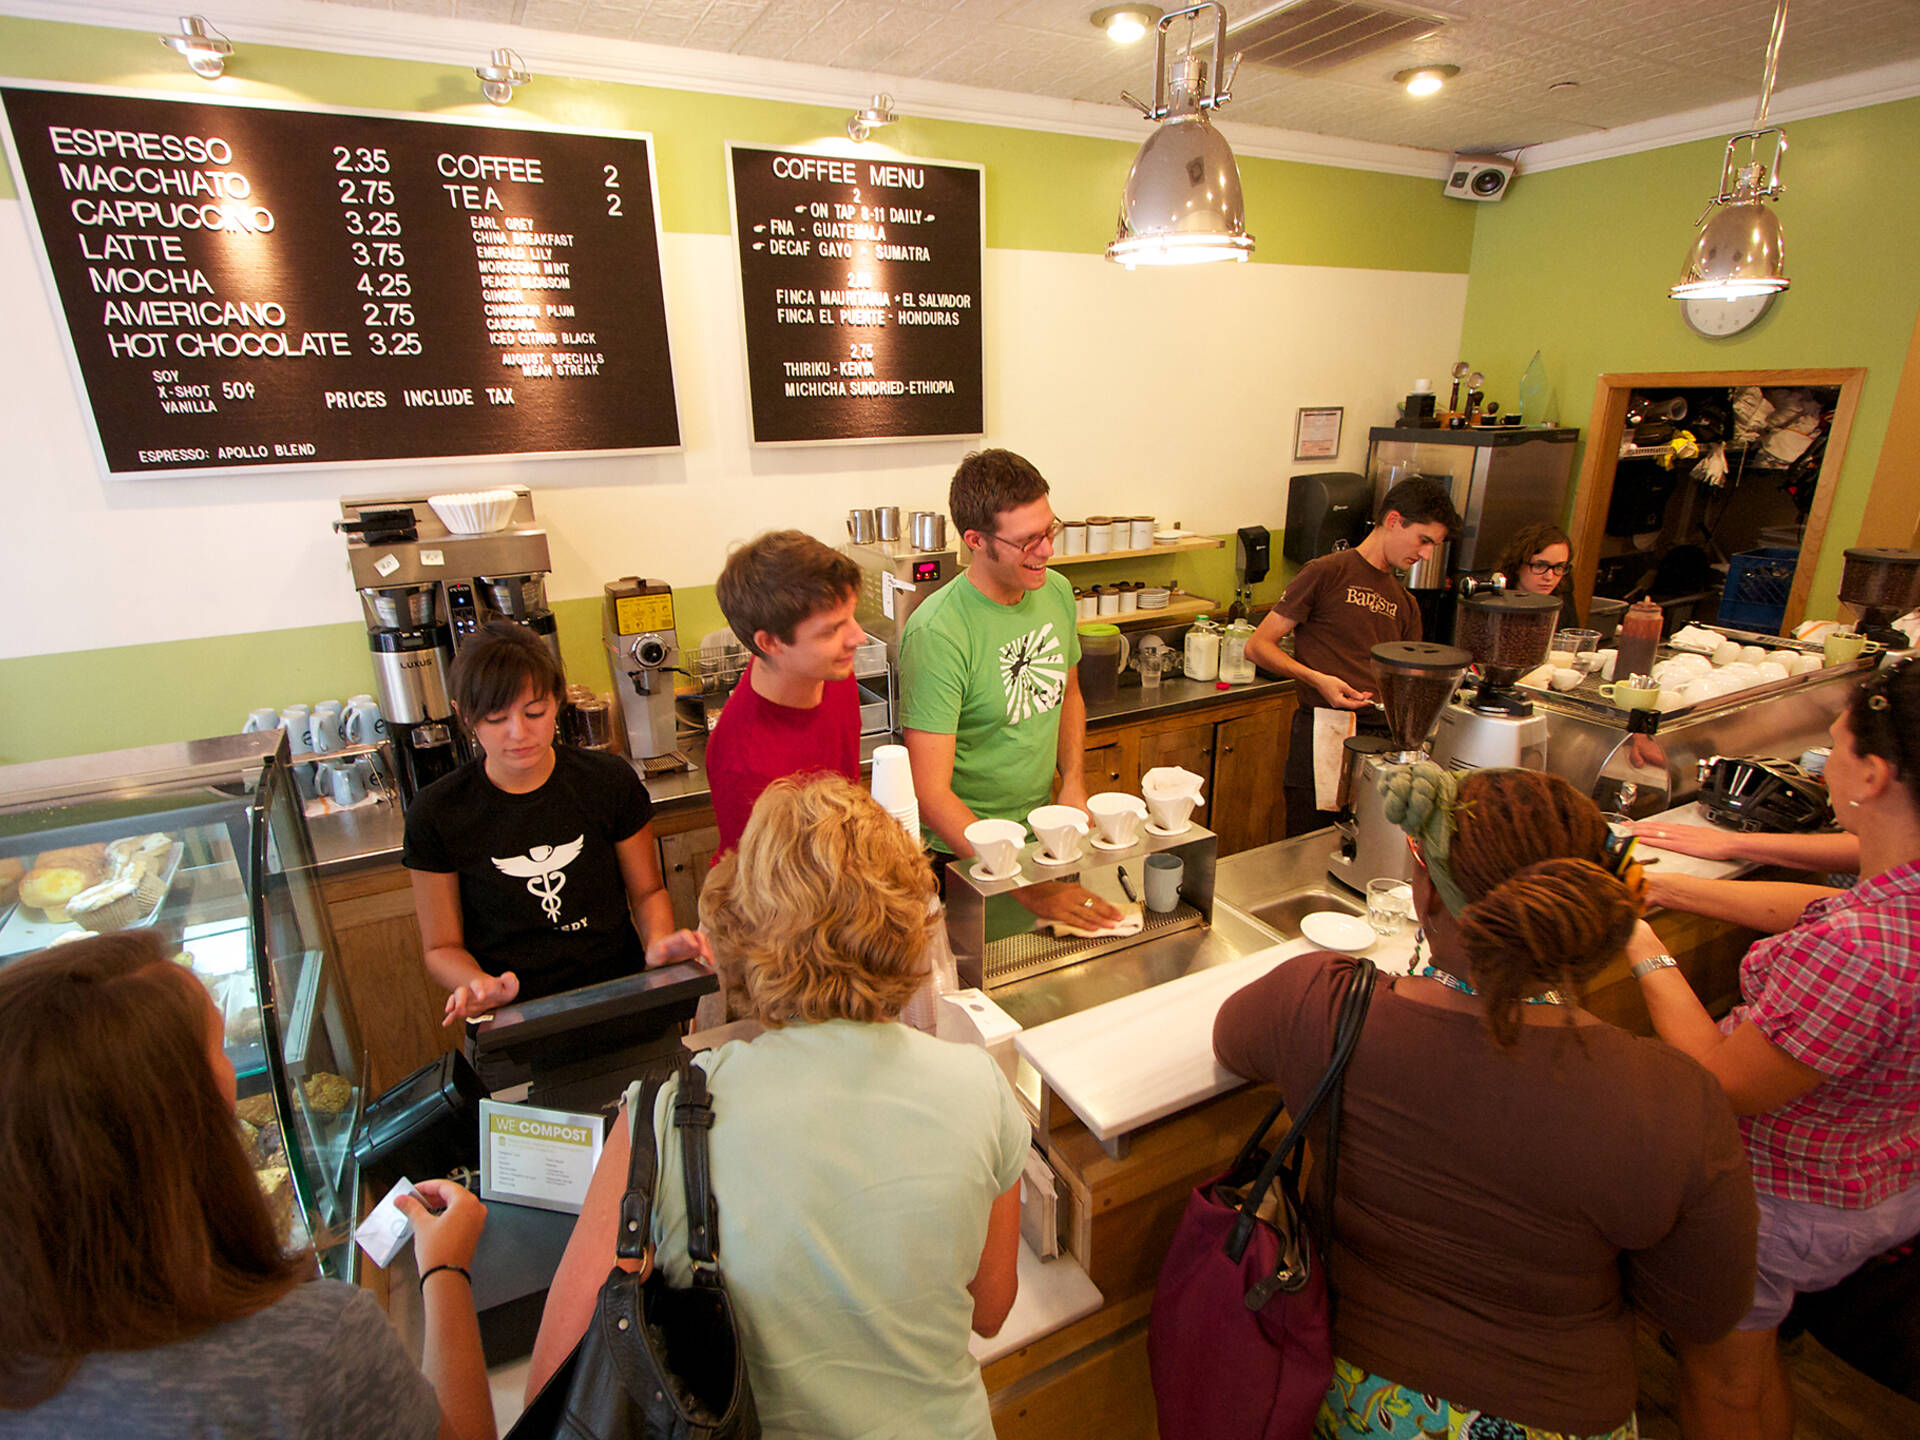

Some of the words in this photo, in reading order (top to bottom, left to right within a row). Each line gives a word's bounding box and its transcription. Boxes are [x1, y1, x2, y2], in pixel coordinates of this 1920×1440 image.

[49, 126, 232, 165] ESPRESSO
[333, 146, 390, 174] 2.35
[437, 153, 544, 184] COFFEE
[603, 164, 620, 189] 2
[772, 157, 857, 185] COFFEE
[870, 164, 925, 189] MENU
[58, 162, 250, 199] MACCHIATO
[338, 179, 395, 206] 2.75
[443, 184, 504, 211] TEA
[606, 193, 623, 217] 2
[852, 188, 861, 204] 2
[71, 199, 274, 233] CAPPUCCNO
[345, 211, 402, 236] 3.25
[810, 203, 829, 219] ON
[834, 204, 856, 220] TAP
[890, 207, 922, 225] DAILY
[471, 215, 499, 230] EARL
[505, 217, 534, 231] GREY
[770, 219, 795, 236] FNA
[472, 231, 508, 245] CHINA
[512, 232, 574, 247] BREAKFAST
[79, 233, 186, 262] LATTE
[352, 243, 405, 267] 3.75
[476, 246, 525, 260] EMERALD
[530, 247, 552, 261] LILY
[770, 239, 811, 257] DECAF
[819, 242, 851, 258] GAYO
[875, 244, 931, 262] SUMATRA
[544, 262, 570, 275] MINT
[88, 268, 214, 294] MOCHA
[357, 274, 412, 297] 4.25
[481, 275, 517, 289] PEACH
[776, 289, 815, 305] FINCA
[903, 292, 915, 307] EL
[918, 293, 971, 309] SALVADOR
[103, 301, 286, 327] AMERICANO
[362, 304, 415, 327] 2.75
[546, 304, 575, 317] PLUM
[777, 308, 814, 324] FINCA
[820, 310, 834, 324] EL
[840, 310, 885, 326] PUENTE
[898, 310, 960, 326] HONDURAS
[108, 332, 167, 358] HOT
[177, 332, 351, 358] CHOCOLATE
[368, 333, 423, 356] 3.25
[489, 332, 515, 345] ICED
[517, 332, 557, 345] CITRUS
[561, 332, 597, 345] BLACK
[502, 353, 545, 366] AUGUST
[551, 353, 605, 365] SPECIALS
[850, 344, 874, 360] 2.75
[152, 370, 179, 383] SOY
[556, 364, 600, 377] STREAK
[784, 362, 830, 376] THIRIKU
[839, 361, 875, 377] KENYA
[156, 384, 211, 400] X-SHOT
[324, 391, 387, 409] PRICES
[403, 389, 473, 407] INCLUDE
[486, 387, 515, 405] TAX
[785, 381, 846, 398] MICHICHA
[161, 400, 218, 415] VANILLA
[139, 450, 210, 463] ESPRESSO:
[218, 445, 268, 460] APOLLO
[275, 442, 316, 457] BLEND
[496, 1117, 516, 1132] WE
[519, 1121, 588, 1143] COMPOST
